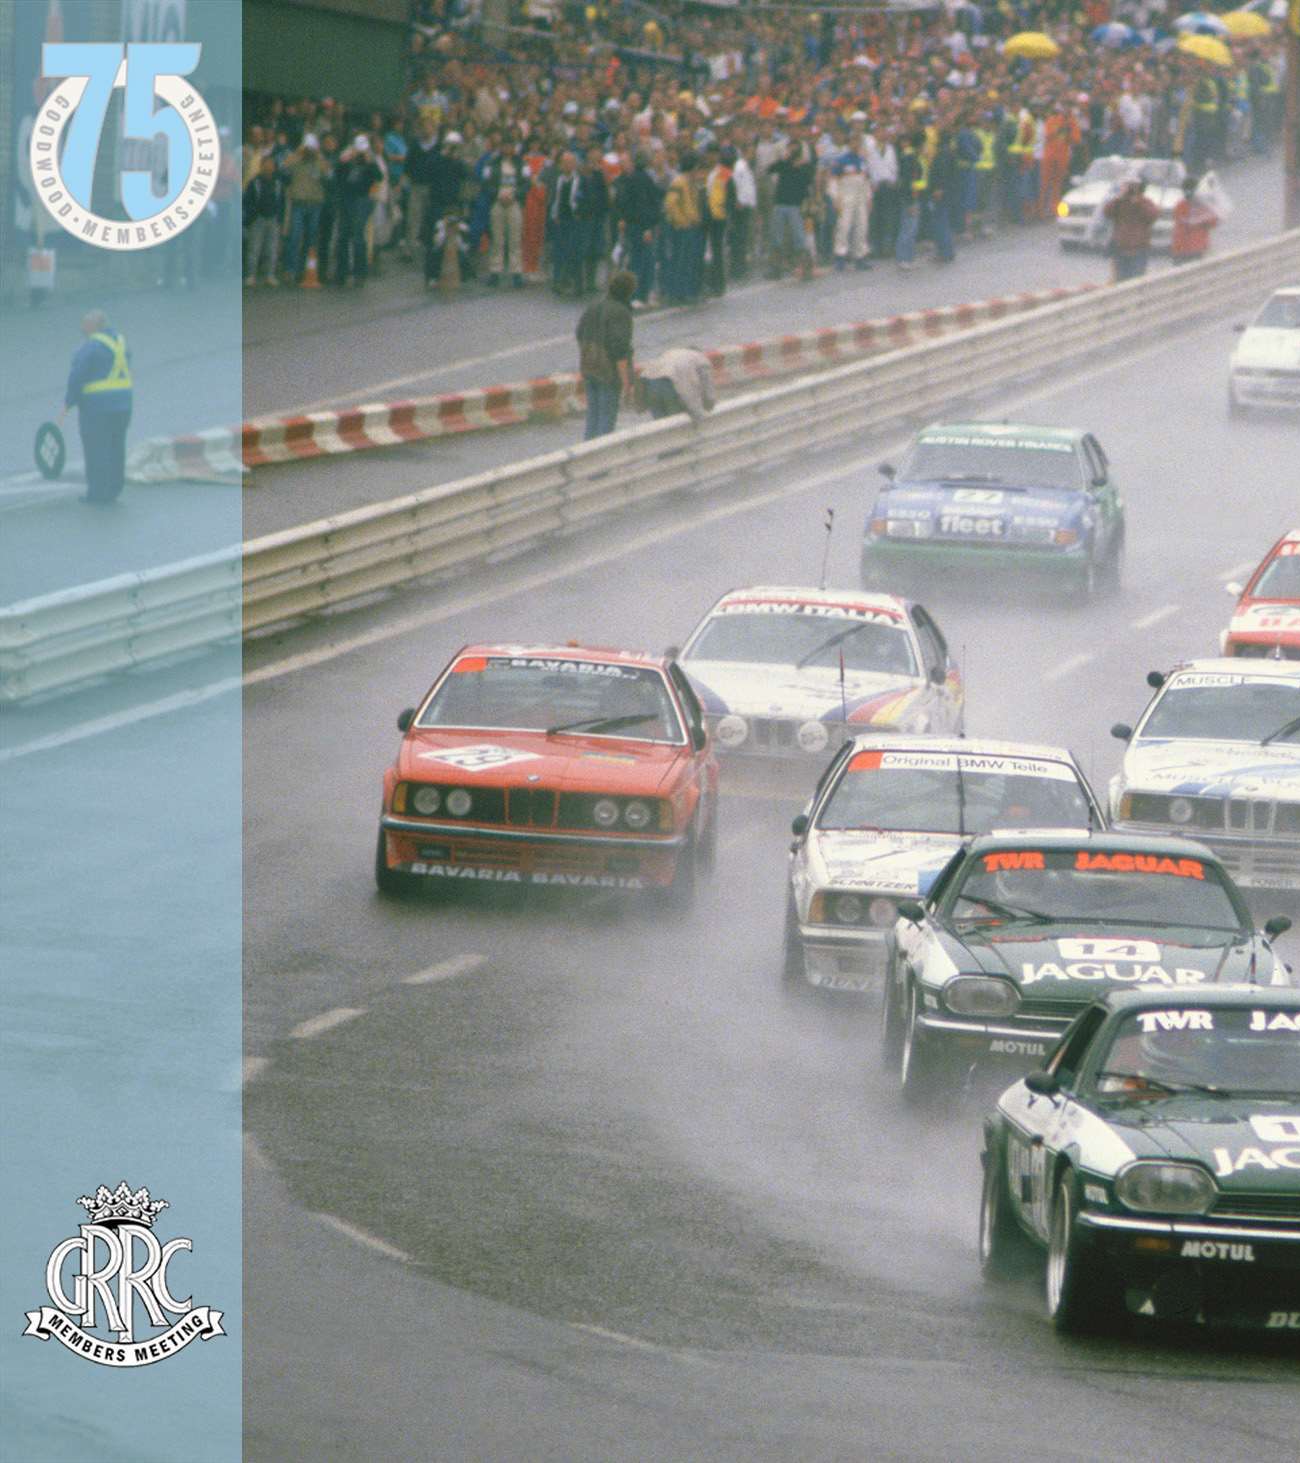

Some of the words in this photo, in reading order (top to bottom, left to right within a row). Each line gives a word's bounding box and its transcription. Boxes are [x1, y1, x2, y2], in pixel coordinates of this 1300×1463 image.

[970, 437, 1016, 448] ROVER
[940, 514, 1004, 535] fleet
[882, 755, 951, 768] Original
[957, 756, 1005, 770] BMW
[1010, 760, 1049, 774] Teile
[410, 862, 522, 882] BAVARIA
[530, 872, 644, 889] BAVARIA
[983, 852, 1045, 873] TWR
[1074, 851, 1204, 880] JAGUAR
[1076, 943, 1146, 957] 14
[1021, 962, 1206, 985] JAGUAR
[1137, 1010, 1214, 1032] TWR
[989, 1039, 1046, 1056] MOTUL
[1181, 1241, 1256, 1262] MOTUL
